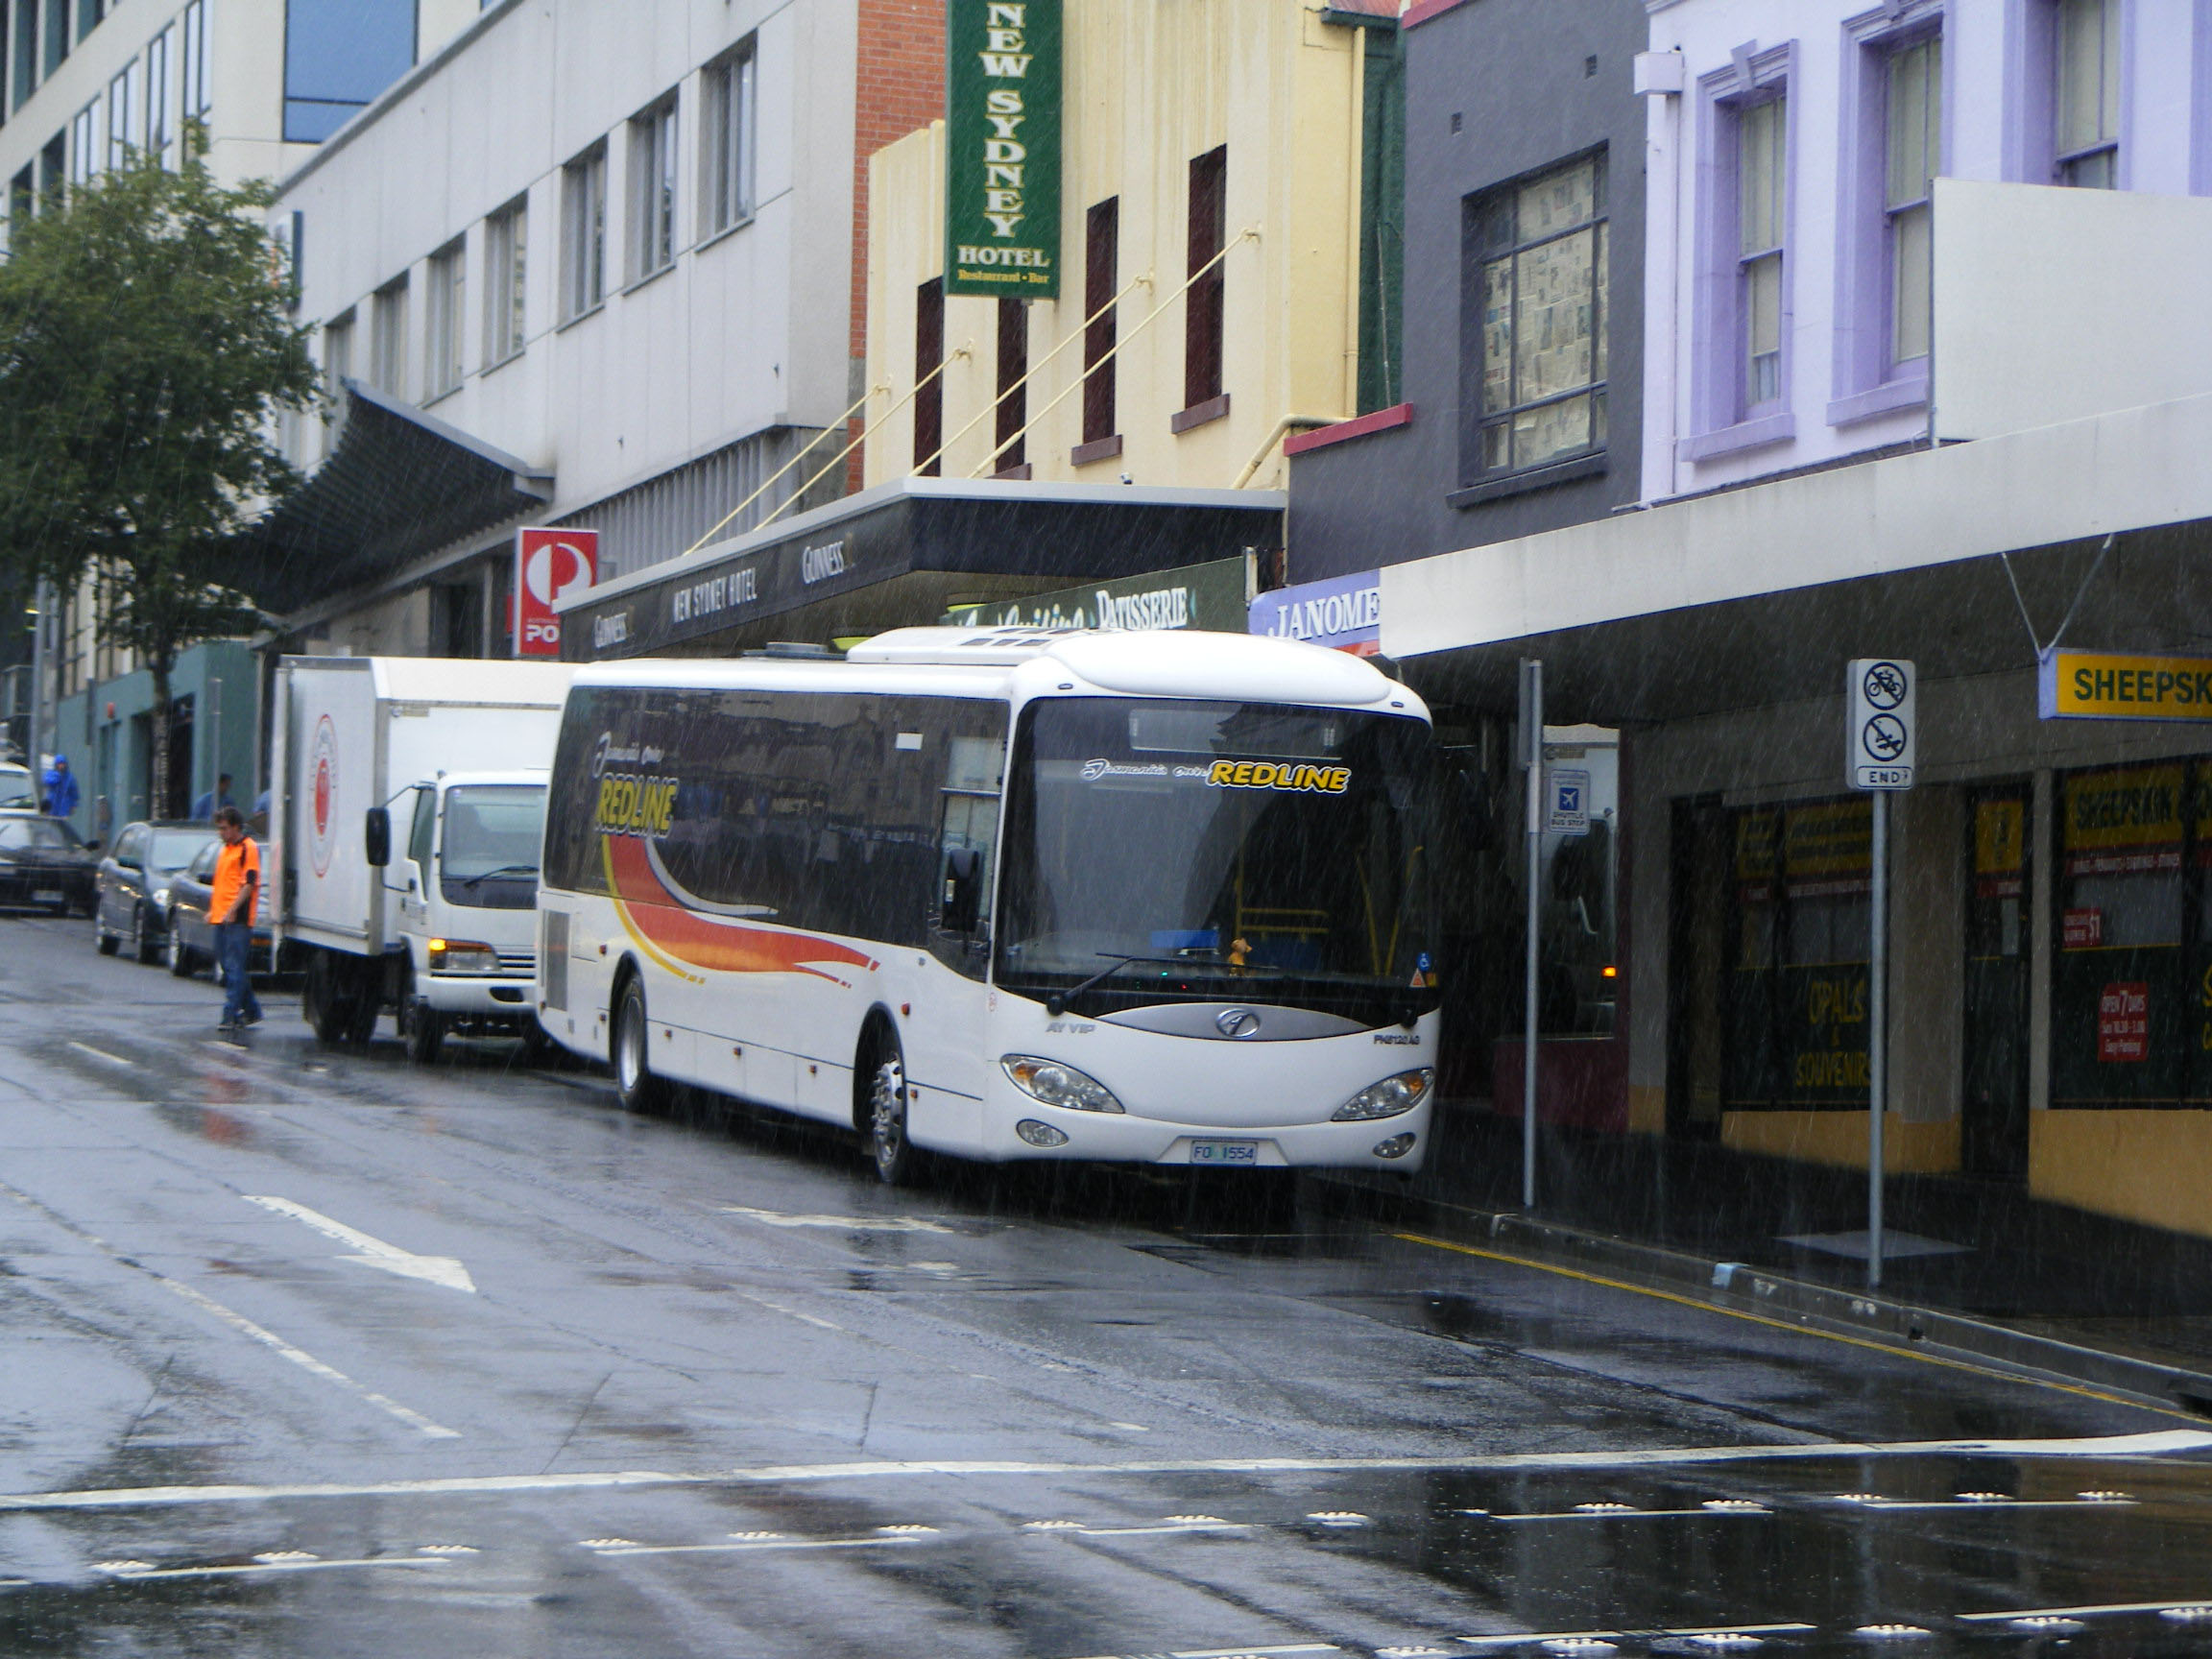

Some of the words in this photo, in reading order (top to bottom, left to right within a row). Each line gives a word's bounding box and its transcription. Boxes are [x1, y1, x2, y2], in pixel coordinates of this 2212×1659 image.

[978, 3, 1034, 78] NEW
[984, 90, 1026, 238] SYDNEY
[957, 246, 1051, 268] HOTEL
[1028, 273, 1049, 284] Bar
[674, 588, 691, 623] NEW
[693, 577, 728, 617] SYDNEY
[729, 566, 757, 607] HOTEL
[1267, 587, 1380, 641] JANOME
[1206, 759, 1352, 793] REDLINE
[1869, 771, 1900, 783] END
[596, 772, 679, 837] REDLINE
[1809, 979, 1865, 1024] OPALS
[2120, 990, 2128, 1017] 7
[1225, 1145, 1255, 1160] 1554
